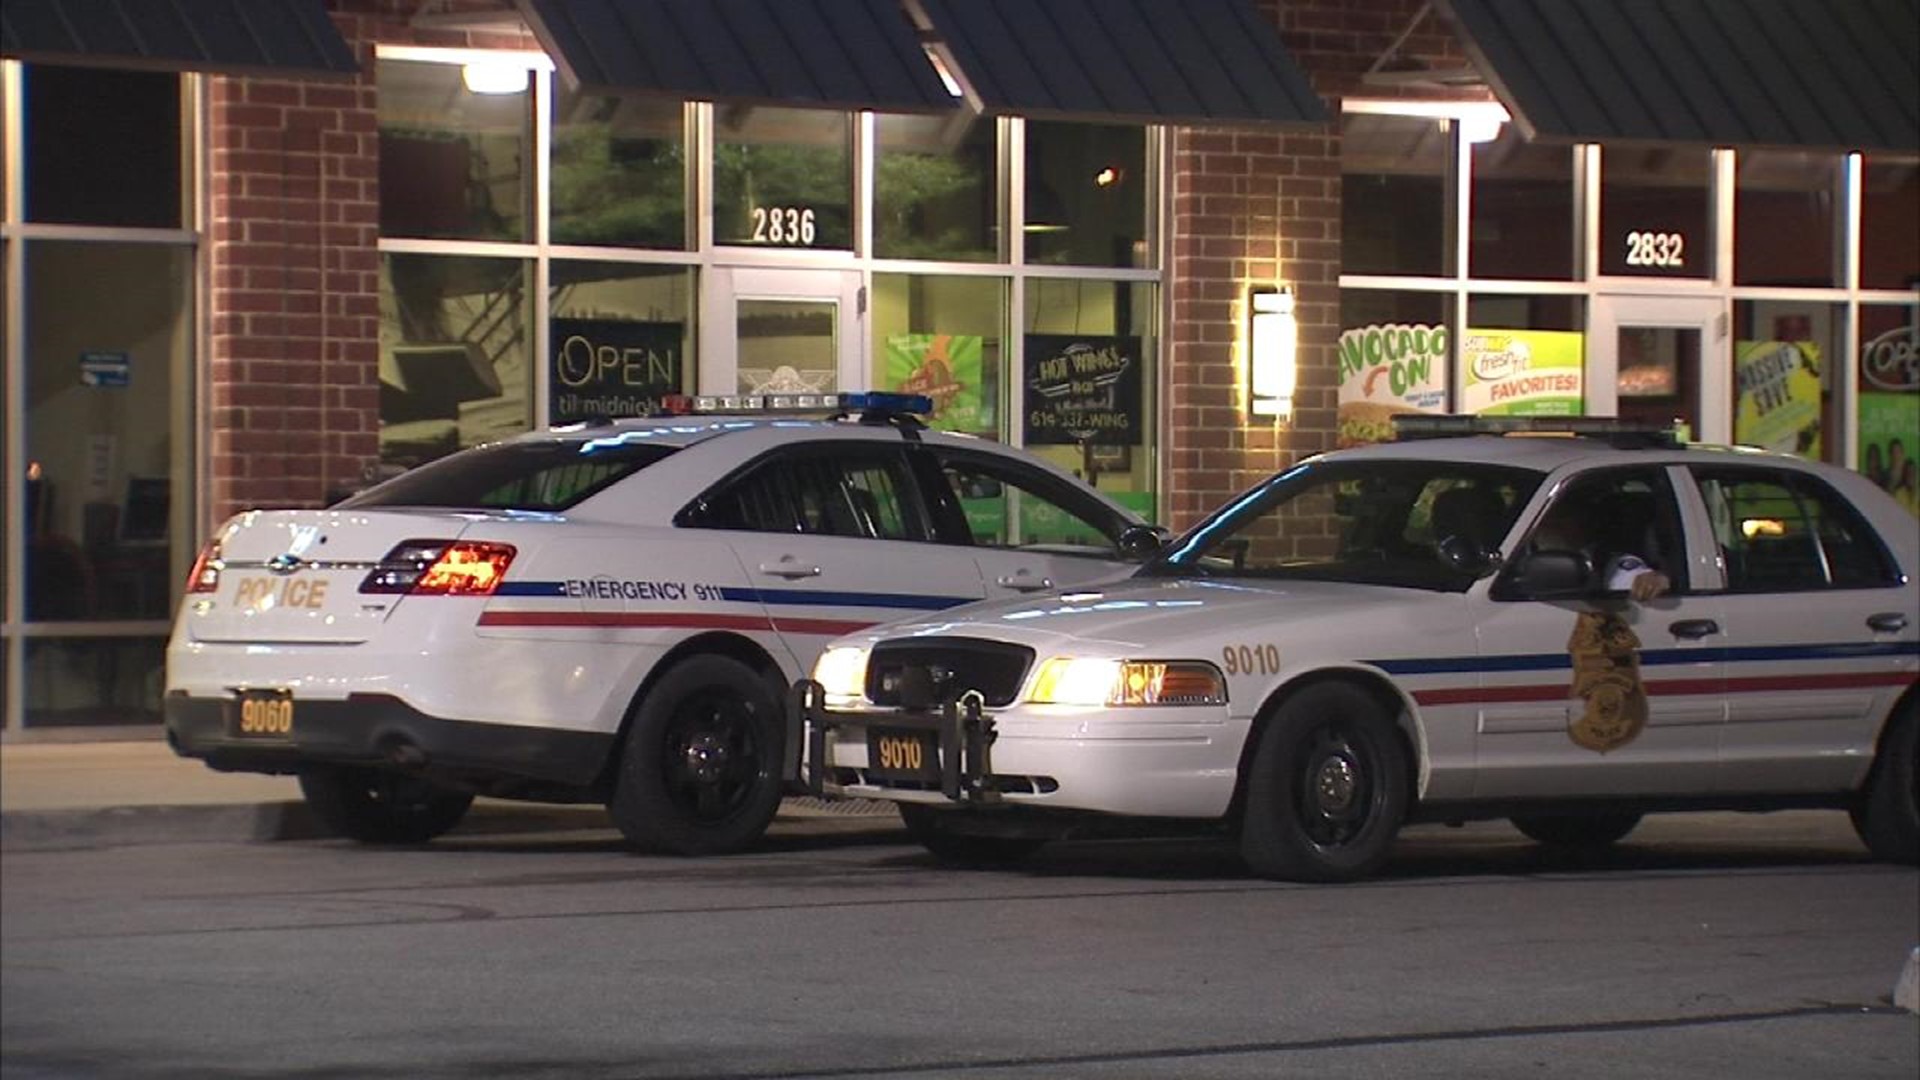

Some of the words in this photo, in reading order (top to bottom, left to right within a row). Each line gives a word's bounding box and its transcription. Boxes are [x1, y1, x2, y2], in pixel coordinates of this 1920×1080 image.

[752, 207, 815, 245] 2836
[1626, 231, 1684, 266] 2832
[557, 335, 673, 386] OPEN
[1039, 357, 1068, 381] HOT
[1337, 329, 1449, 386] AVOCADO
[1389, 353, 1432, 397] ON!
[1490, 374, 1578, 402] FAVORITES!
[583, 395, 663, 417] midnigh
[232, 577, 330, 611] POLICE
[566, 579, 688, 601] EMERGENCY
[693, 584, 722, 601] 911
[1222, 643, 1280, 676] 9010
[241, 699, 293, 733] 9060
[879, 736, 922, 769] 9010
